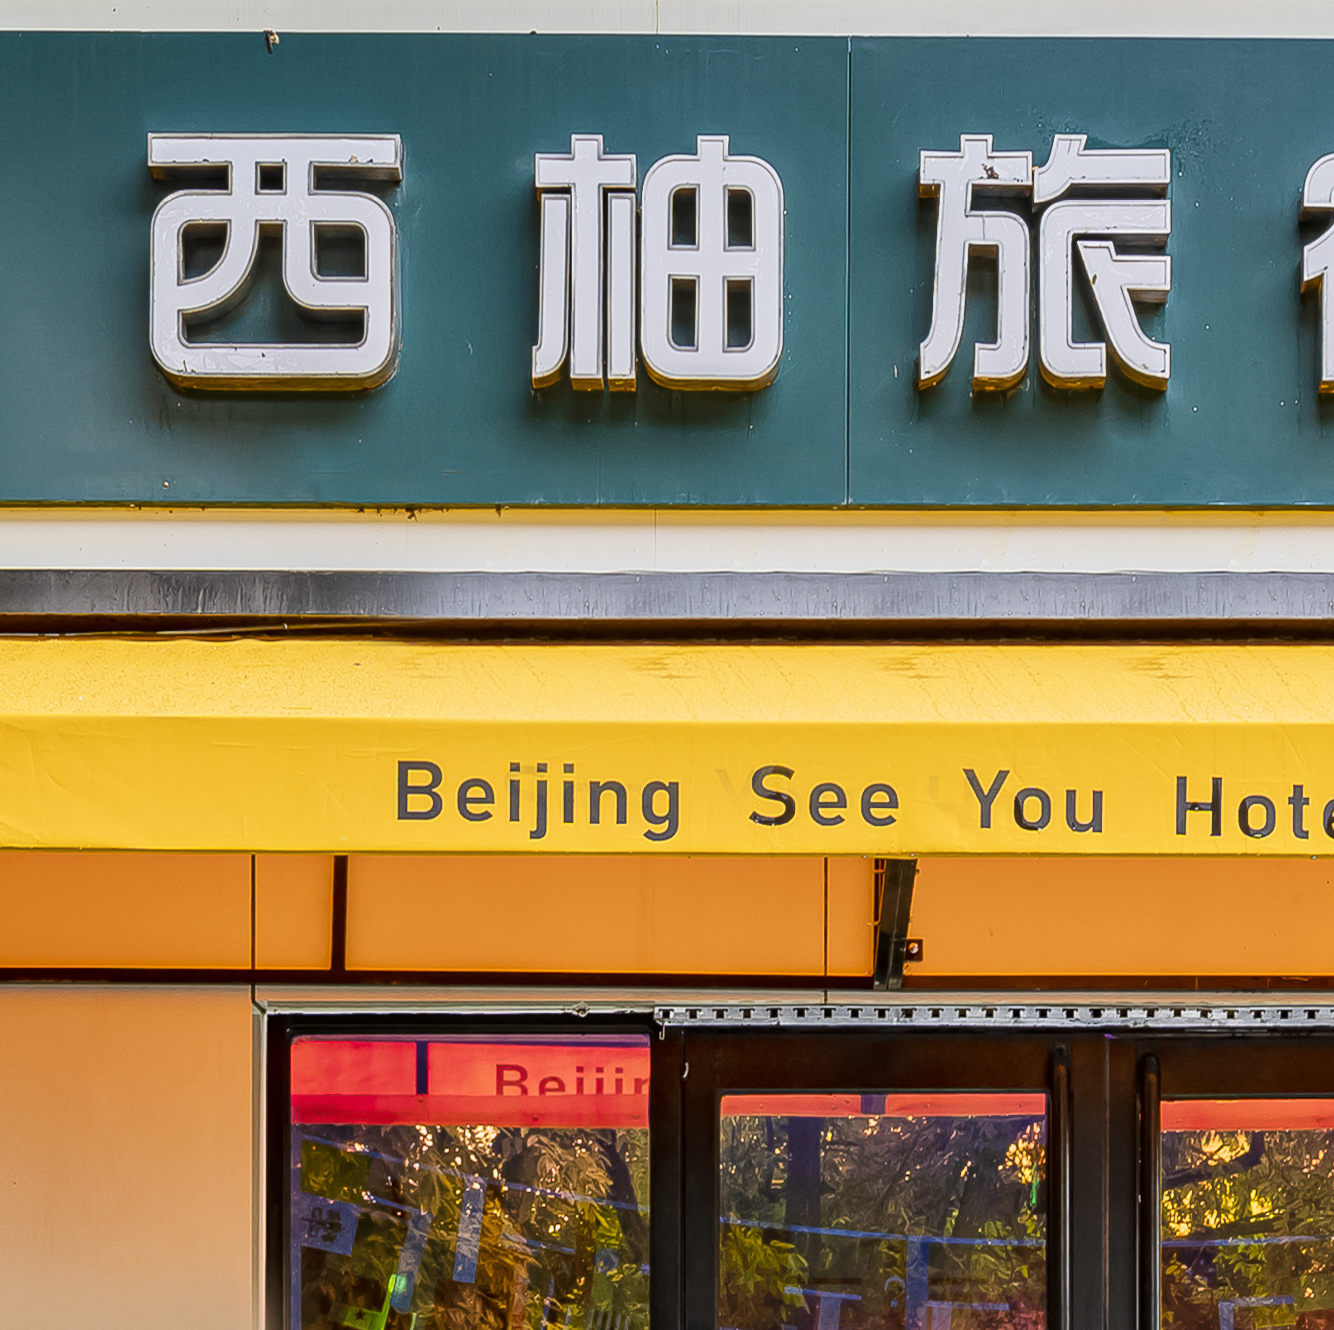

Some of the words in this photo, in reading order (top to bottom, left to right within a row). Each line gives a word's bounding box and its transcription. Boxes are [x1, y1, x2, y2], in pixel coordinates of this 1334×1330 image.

[396, 759, 681, 843] Beijing
[748, 764, 900, 828] See
[962, 767, 1105, 834] You
